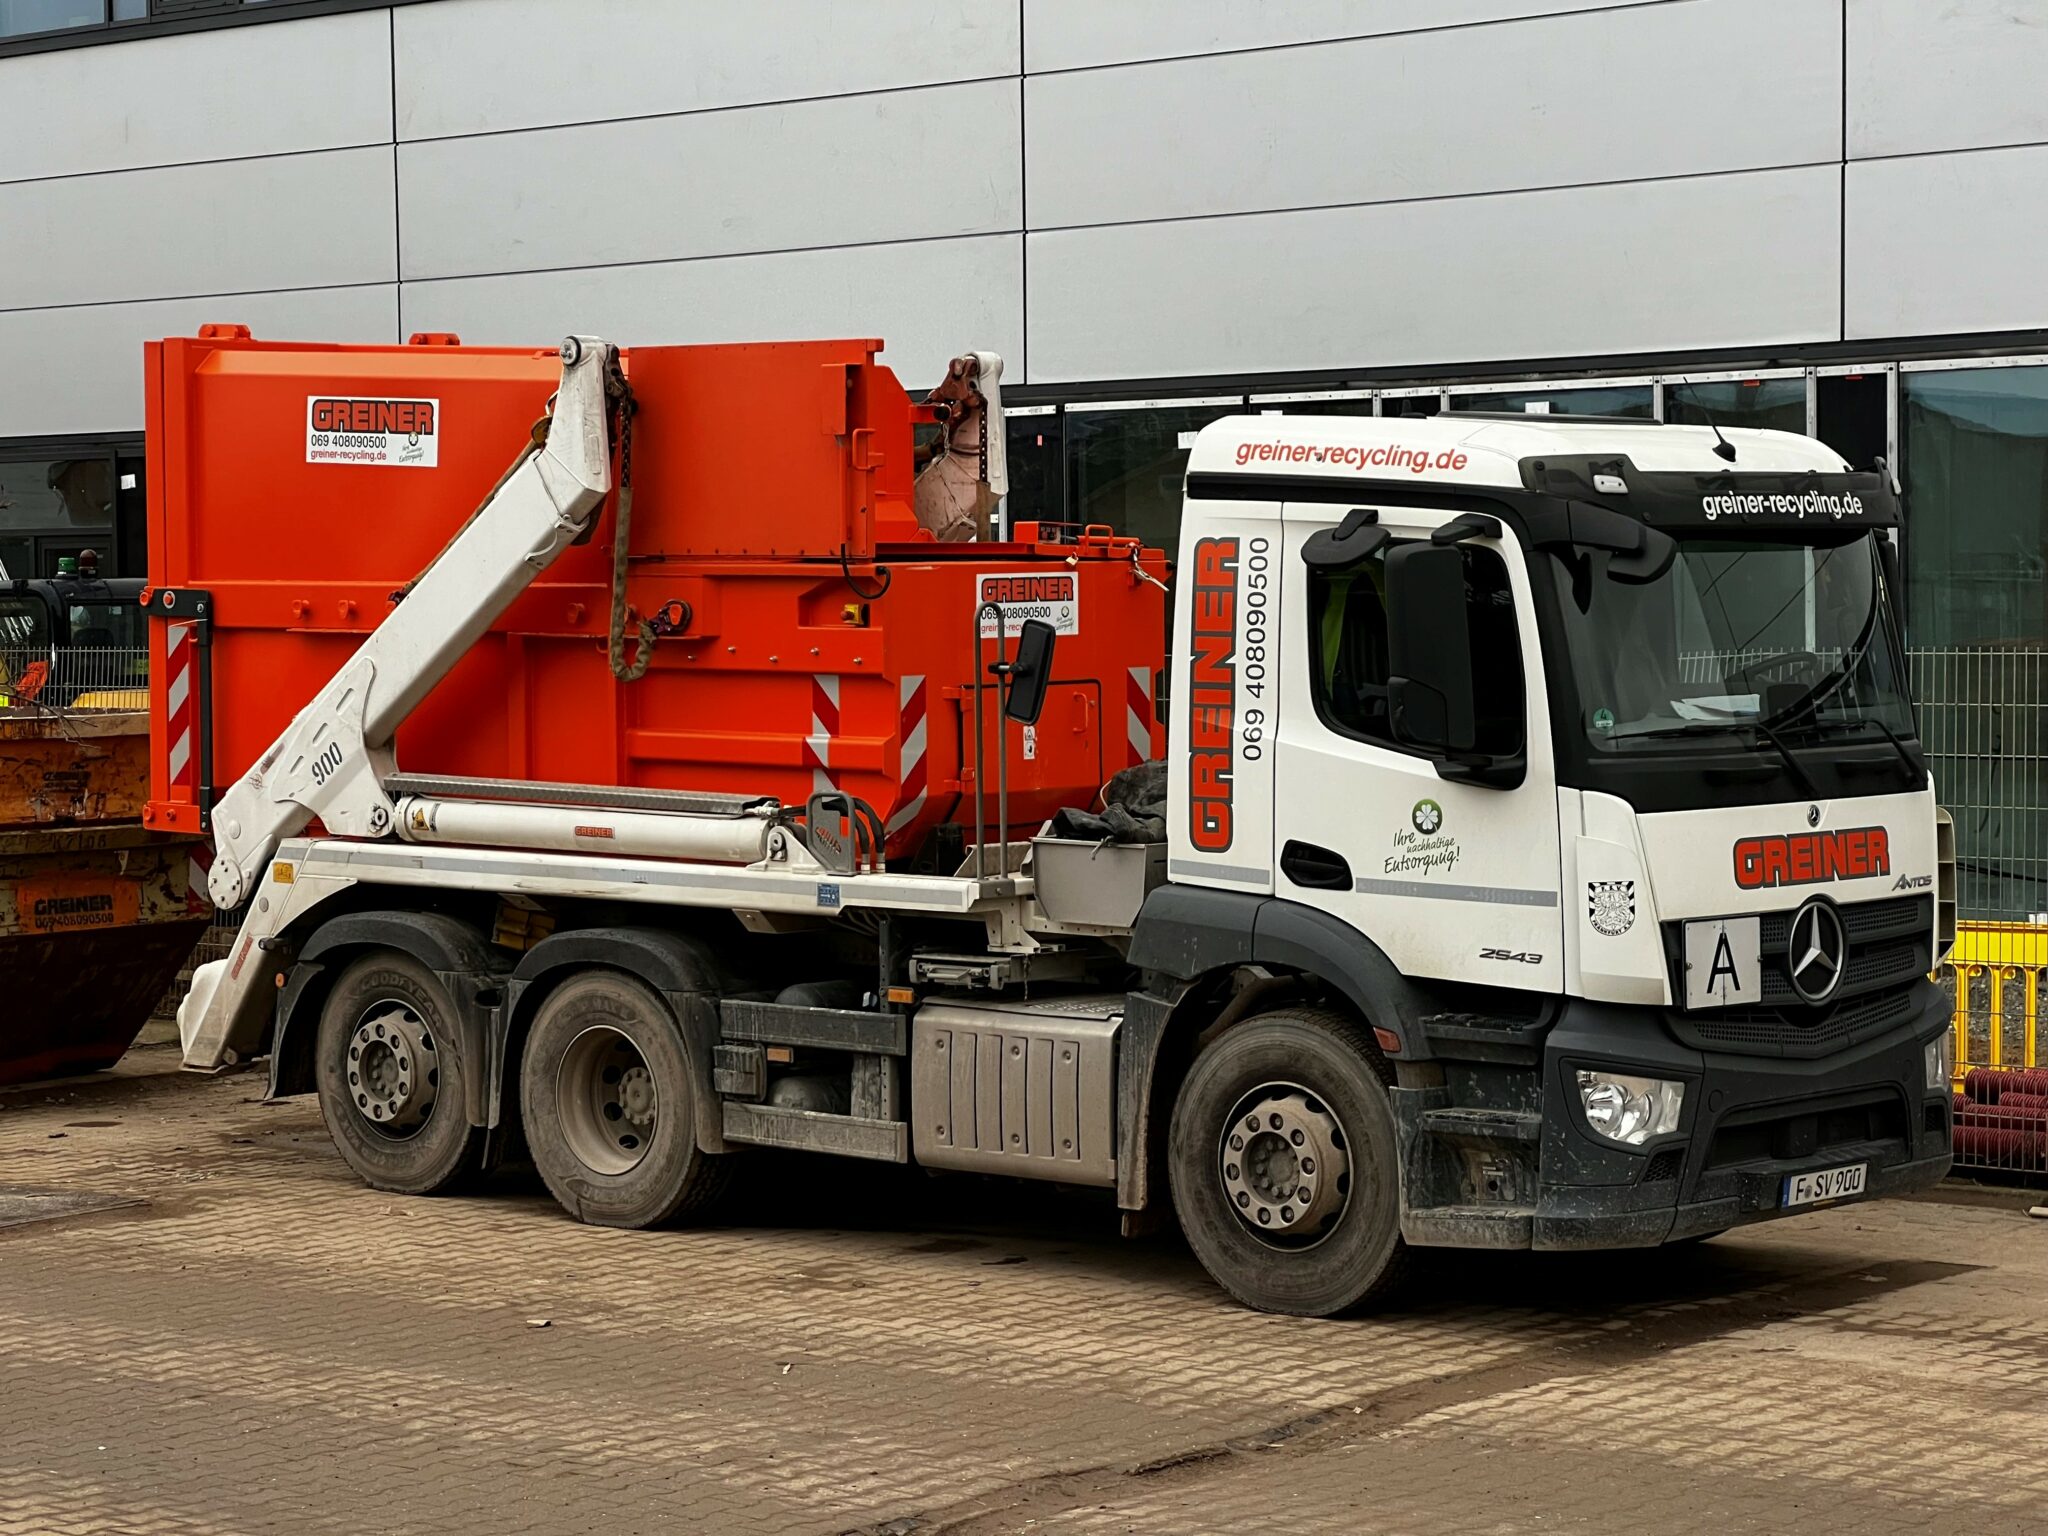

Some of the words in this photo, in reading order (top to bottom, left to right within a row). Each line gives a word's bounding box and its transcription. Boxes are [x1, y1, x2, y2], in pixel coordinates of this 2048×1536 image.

[312, 399, 434, 435] GREINER
[311, 434, 329, 447] 069
[332, 435, 387, 448] 408090500
[311, 449, 387, 462] greiner-recycling.de
[1236, 440, 1468, 473] greiner-recycling.de
[1702, 490, 1863, 520] greiner-recycling.de
[982, 576, 1074, 603] GREINER
[1245, 537, 1269, 699] 408090500
[1189, 536, 1240, 853] GREINER
[1242, 707, 1265, 761] 069
[312, 741, 342, 786] 900
[575, 826, 613, 838] GREINER
[1393, 828, 1416, 847] Ihre
[1407, 837, 1456, 853] nachhaltige
[1384, 846, 1460, 876] Entsorgung!
[1733, 825, 1890, 890] GREINER
[34, 895, 113, 916] GREINER
[1479, 948, 1543, 965] 2543
[1706, 932, 1741, 994] A
[1796, 1177, 1807, 1202] F
[1814, 1172, 1834, 1198] SV
[1835, 1167, 1862, 1194] 900
